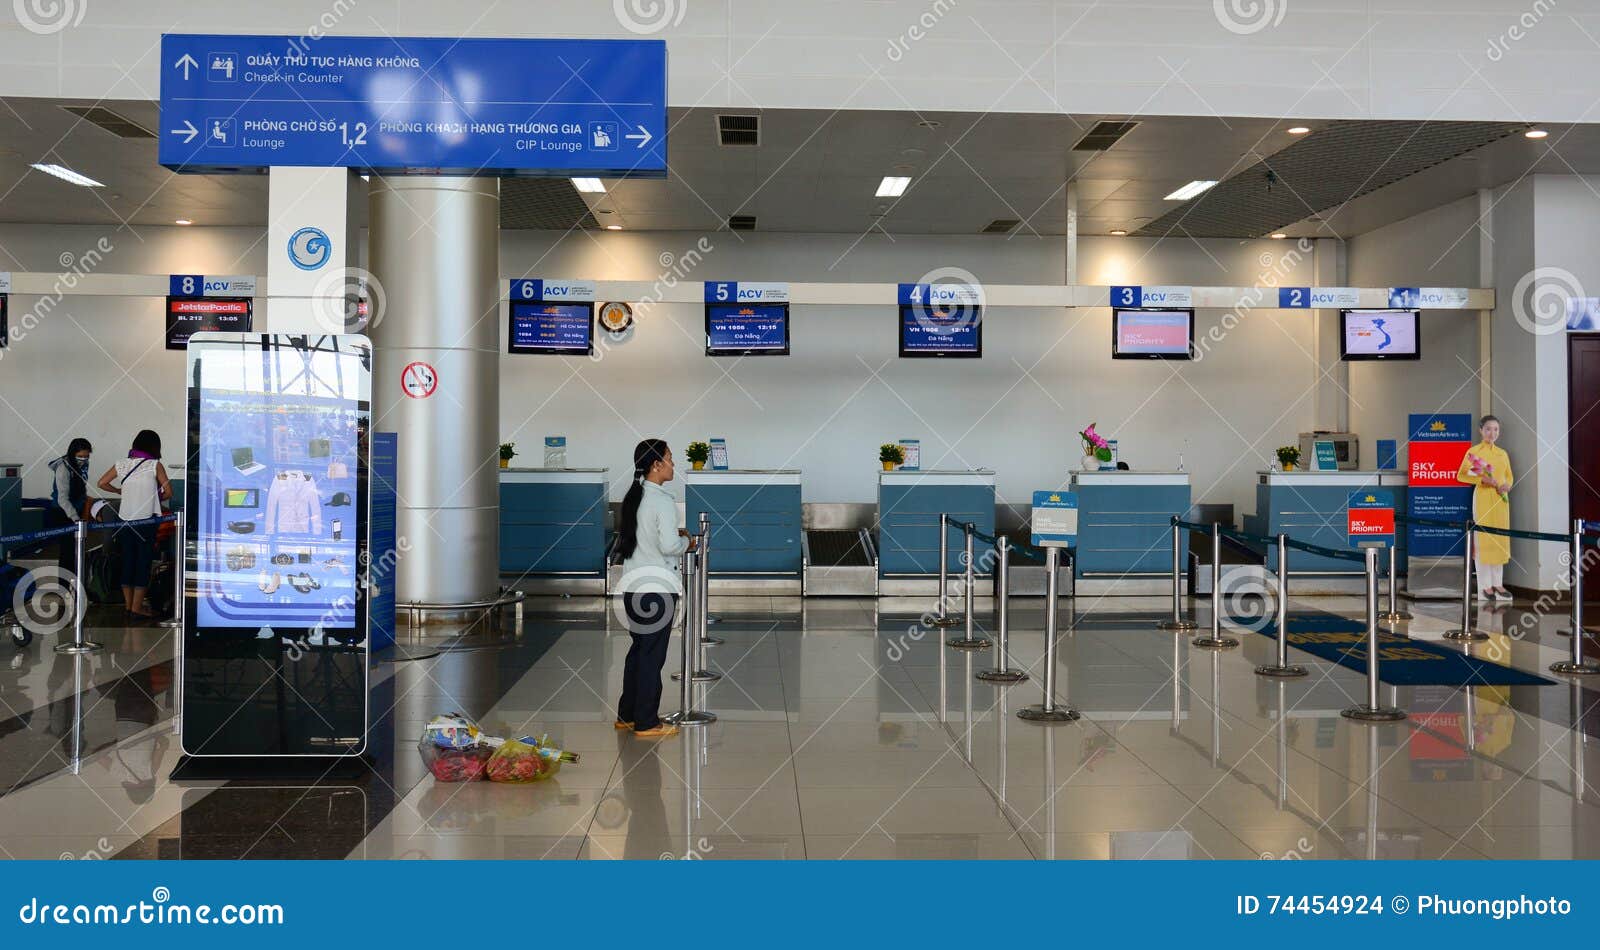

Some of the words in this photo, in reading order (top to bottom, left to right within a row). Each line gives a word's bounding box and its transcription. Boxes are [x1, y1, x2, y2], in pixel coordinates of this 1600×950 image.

[311, 56, 335, 68] TỤC
[376, 56, 420, 68] KHÔNG
[244, 72, 295, 82] Check-in
[298, 72, 343, 83] Counter
[244, 118, 288, 131] PHÒNG
[561, 123, 582, 134] GIA
[242, 138, 286, 150] Lounge
[516, 139, 537, 150] CIP
[541, 140, 583, 153] Lounge
[182, 276, 195, 295] 8
[204, 282, 230, 291] ACV
[521, 281, 534, 299] 6
[544, 286, 569, 296] ACV
[716, 283, 729, 301] 5
[738, 289, 763, 298] ACV
[909, 285, 922, 303] 4
[931, 290, 956, 299] ACV
[1121, 287, 1134, 305] 3
[1142, 293, 1167, 302] ACV
[1290, 289, 1303, 306] 2
[1311, 294, 1335, 303] ACV
[1401, 289, 1409, 306] 1
[1412, 462, 1435, 471] SKY
[1412, 470, 1458, 480] PRIORIT
